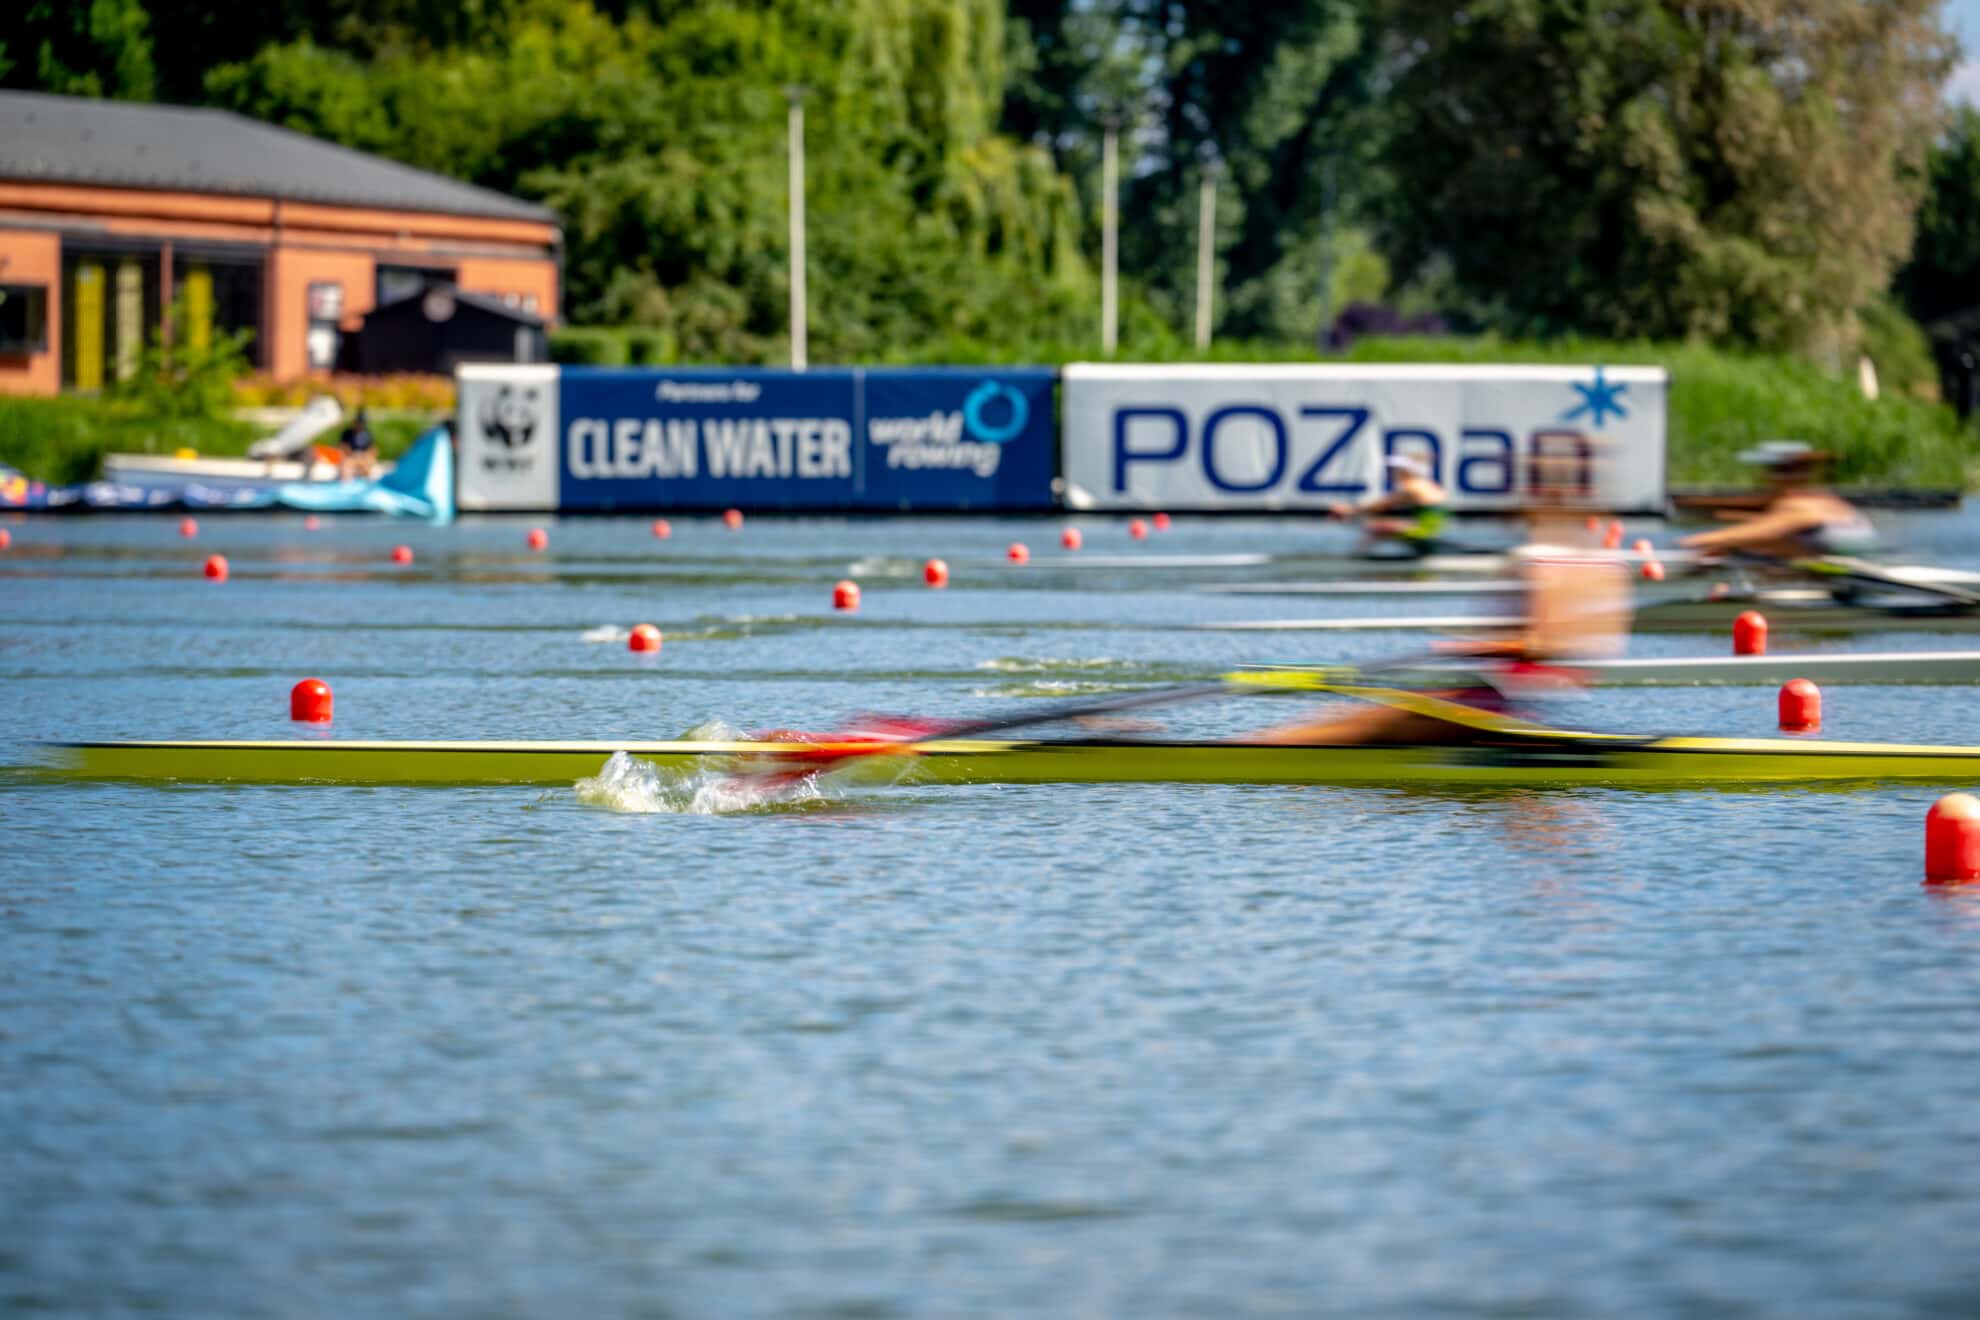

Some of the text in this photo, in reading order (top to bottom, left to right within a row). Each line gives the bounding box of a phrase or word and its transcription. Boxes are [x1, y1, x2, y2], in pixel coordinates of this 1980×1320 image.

[868, 411, 964, 445] world
[567, 418, 852, 479] CLEAN WATER
[887, 441, 1001, 477] rowing
